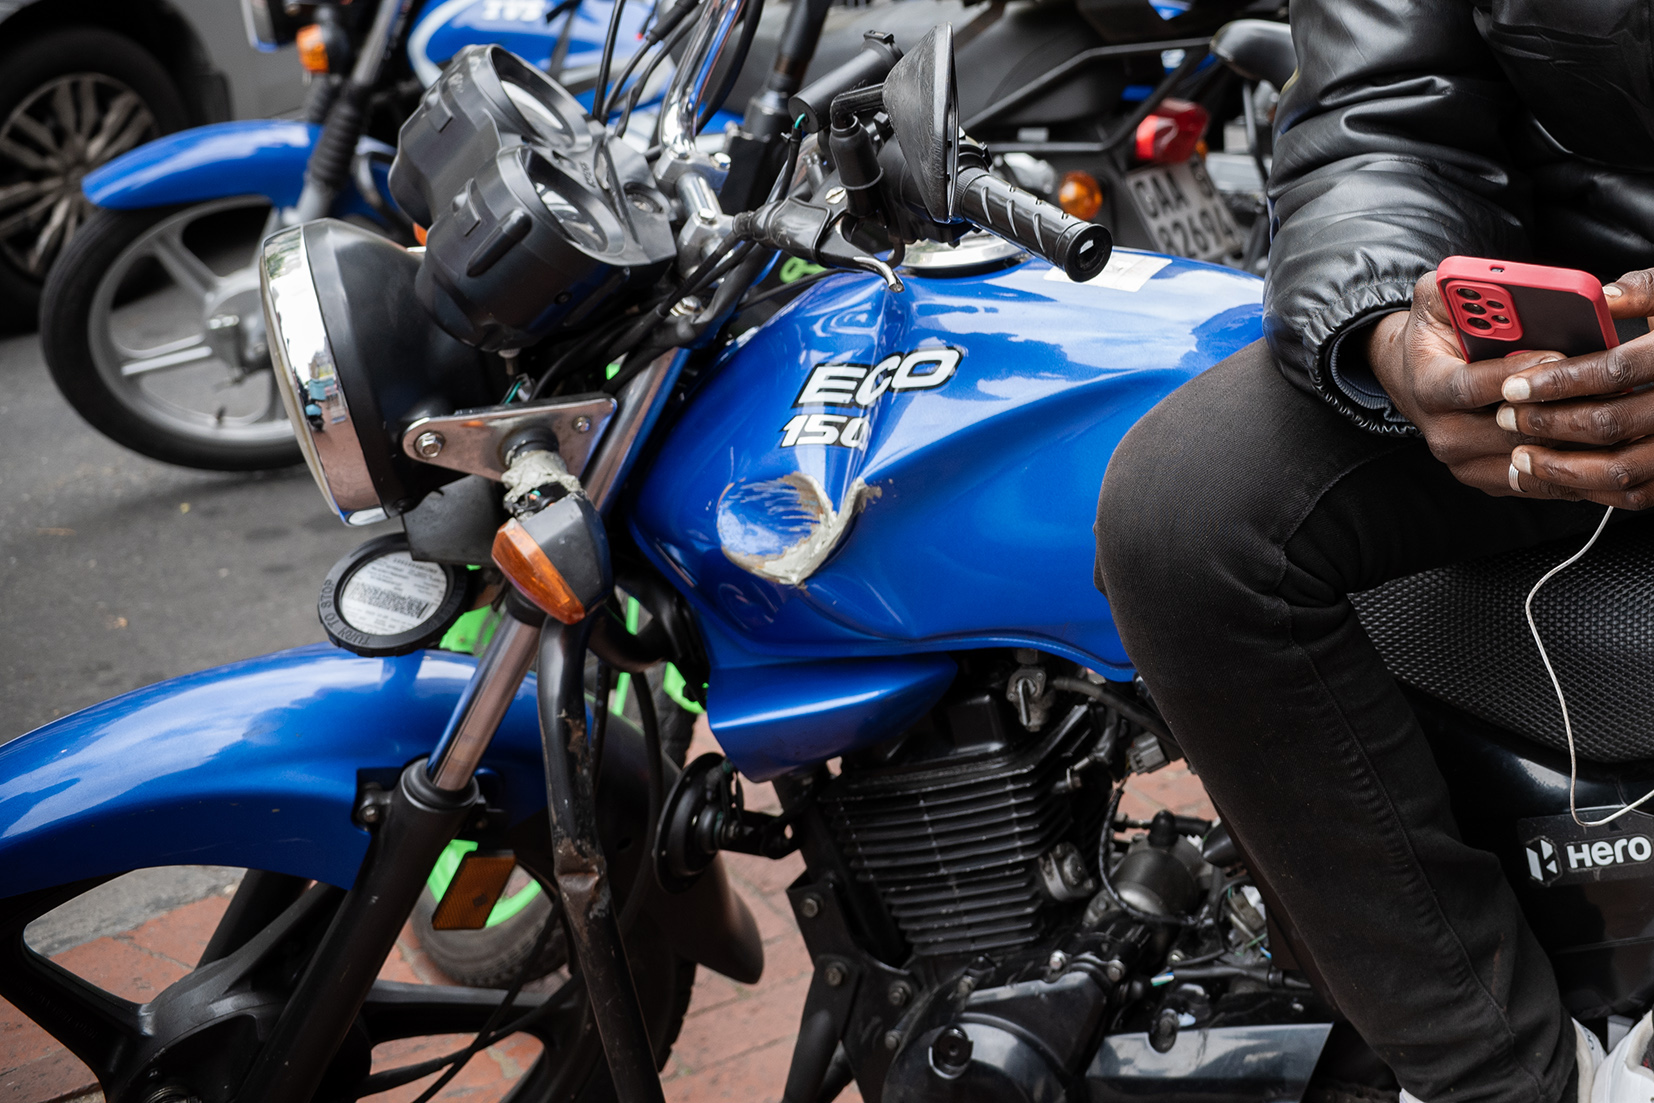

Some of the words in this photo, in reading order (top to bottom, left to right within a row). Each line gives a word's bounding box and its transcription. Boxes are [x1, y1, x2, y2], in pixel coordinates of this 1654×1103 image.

[795, 347, 963, 407] ECO
[780, 414, 871, 450] 150
[1566, 836, 1653, 869] Hero
